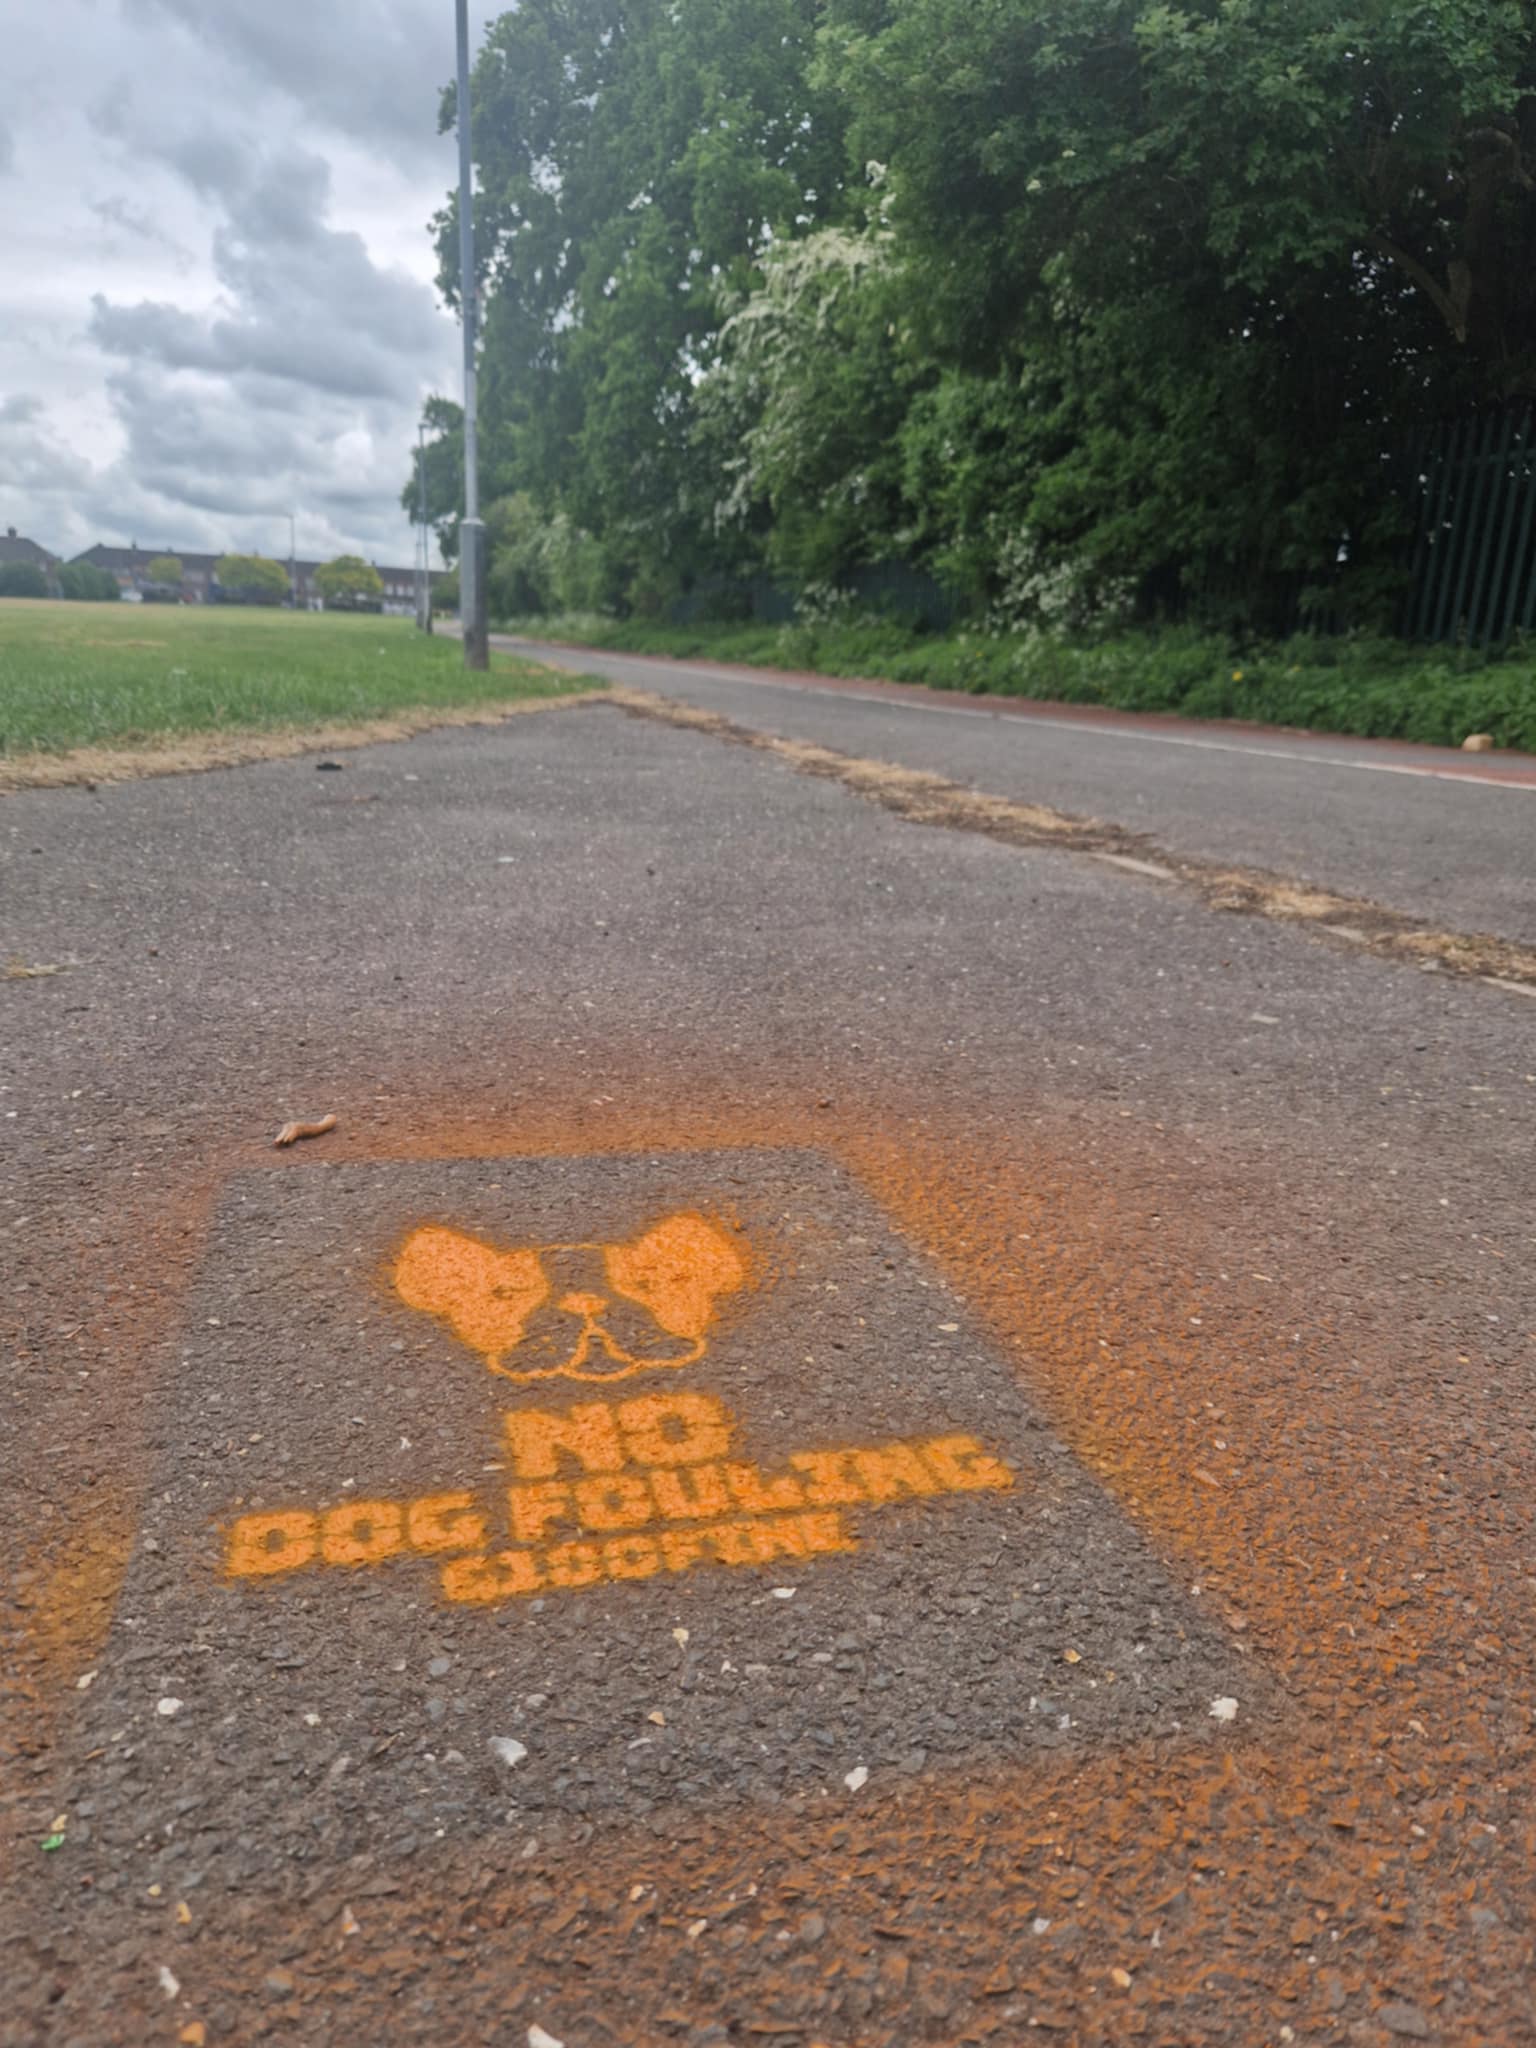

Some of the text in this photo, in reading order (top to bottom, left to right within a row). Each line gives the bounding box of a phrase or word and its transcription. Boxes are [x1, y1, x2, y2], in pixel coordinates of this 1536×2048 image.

[506, 1393, 732, 1480] NO
[222, 1434, 1015, 1578] DOG FOULING
